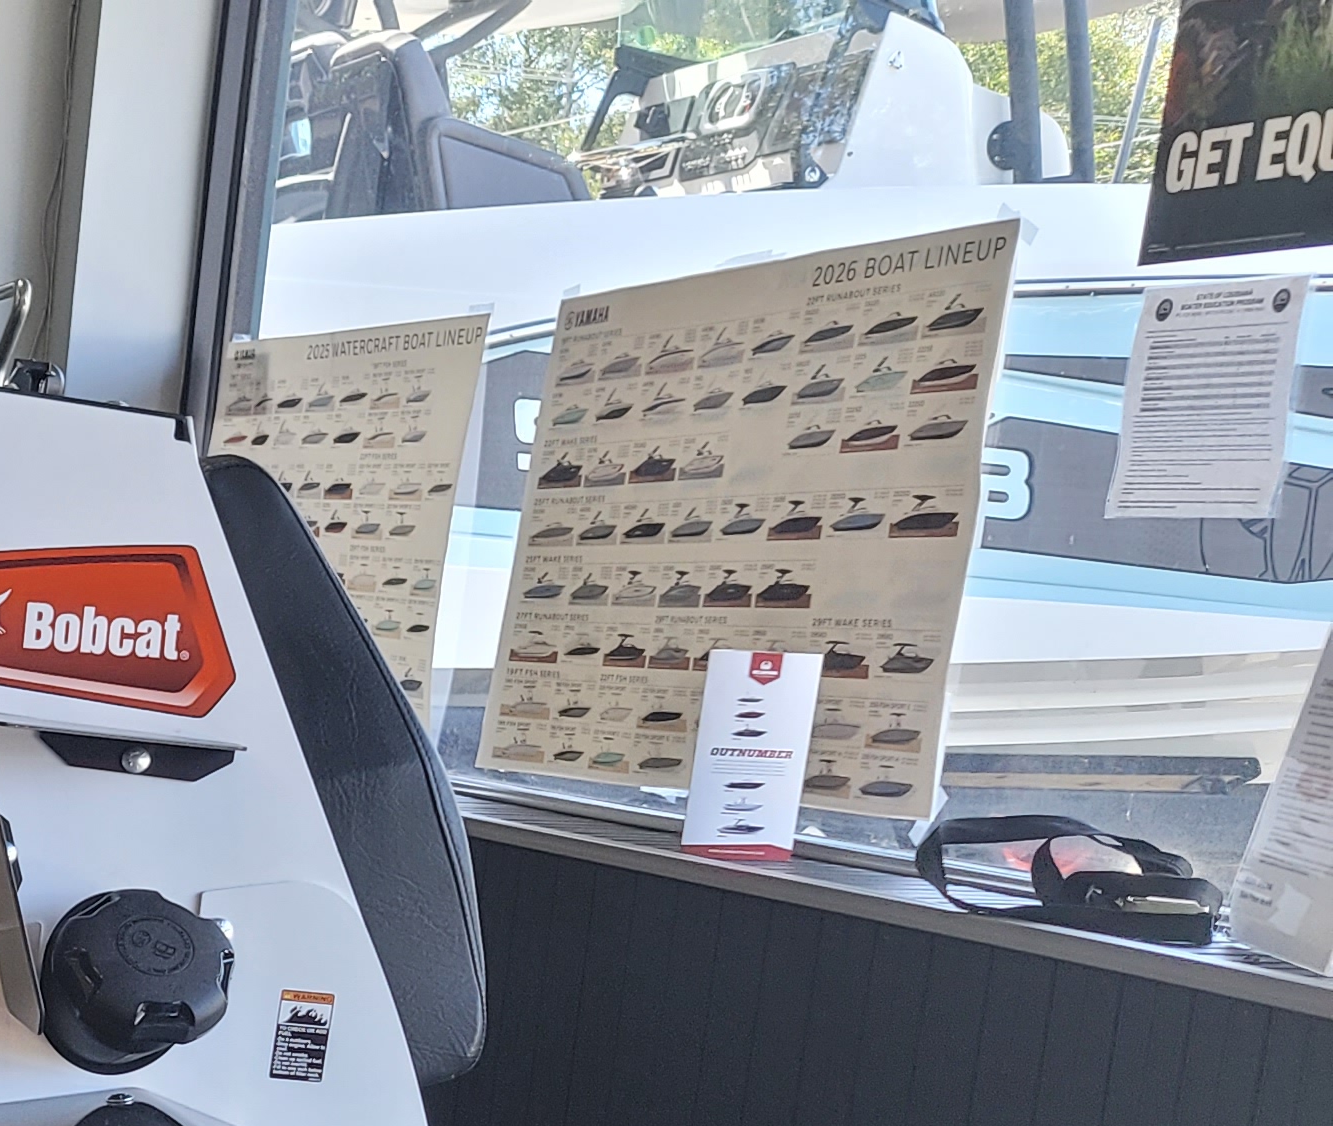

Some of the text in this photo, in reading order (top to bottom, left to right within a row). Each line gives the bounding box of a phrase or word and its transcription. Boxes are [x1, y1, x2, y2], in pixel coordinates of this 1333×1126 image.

[1166, 122, 1254, 194] GET
[812, 236, 1007, 288] 2026 BOAT LINEUP
[826, 287, 871, 303] RUNABOUT
[872, 283, 902, 295] SERIES
[574, 305, 610, 328] YAMAHA
[403, 331, 434, 351] BOAT
[435, 326, 483, 347] LINEUP
[23, 601, 183, 662] Bobcat
[834, 618, 859, 628] WAKE
[861, 618, 893, 628] SERIES
[710, 747, 794, 760] OUTNUMBER
[293, 993, 332, 1003] WARNING
